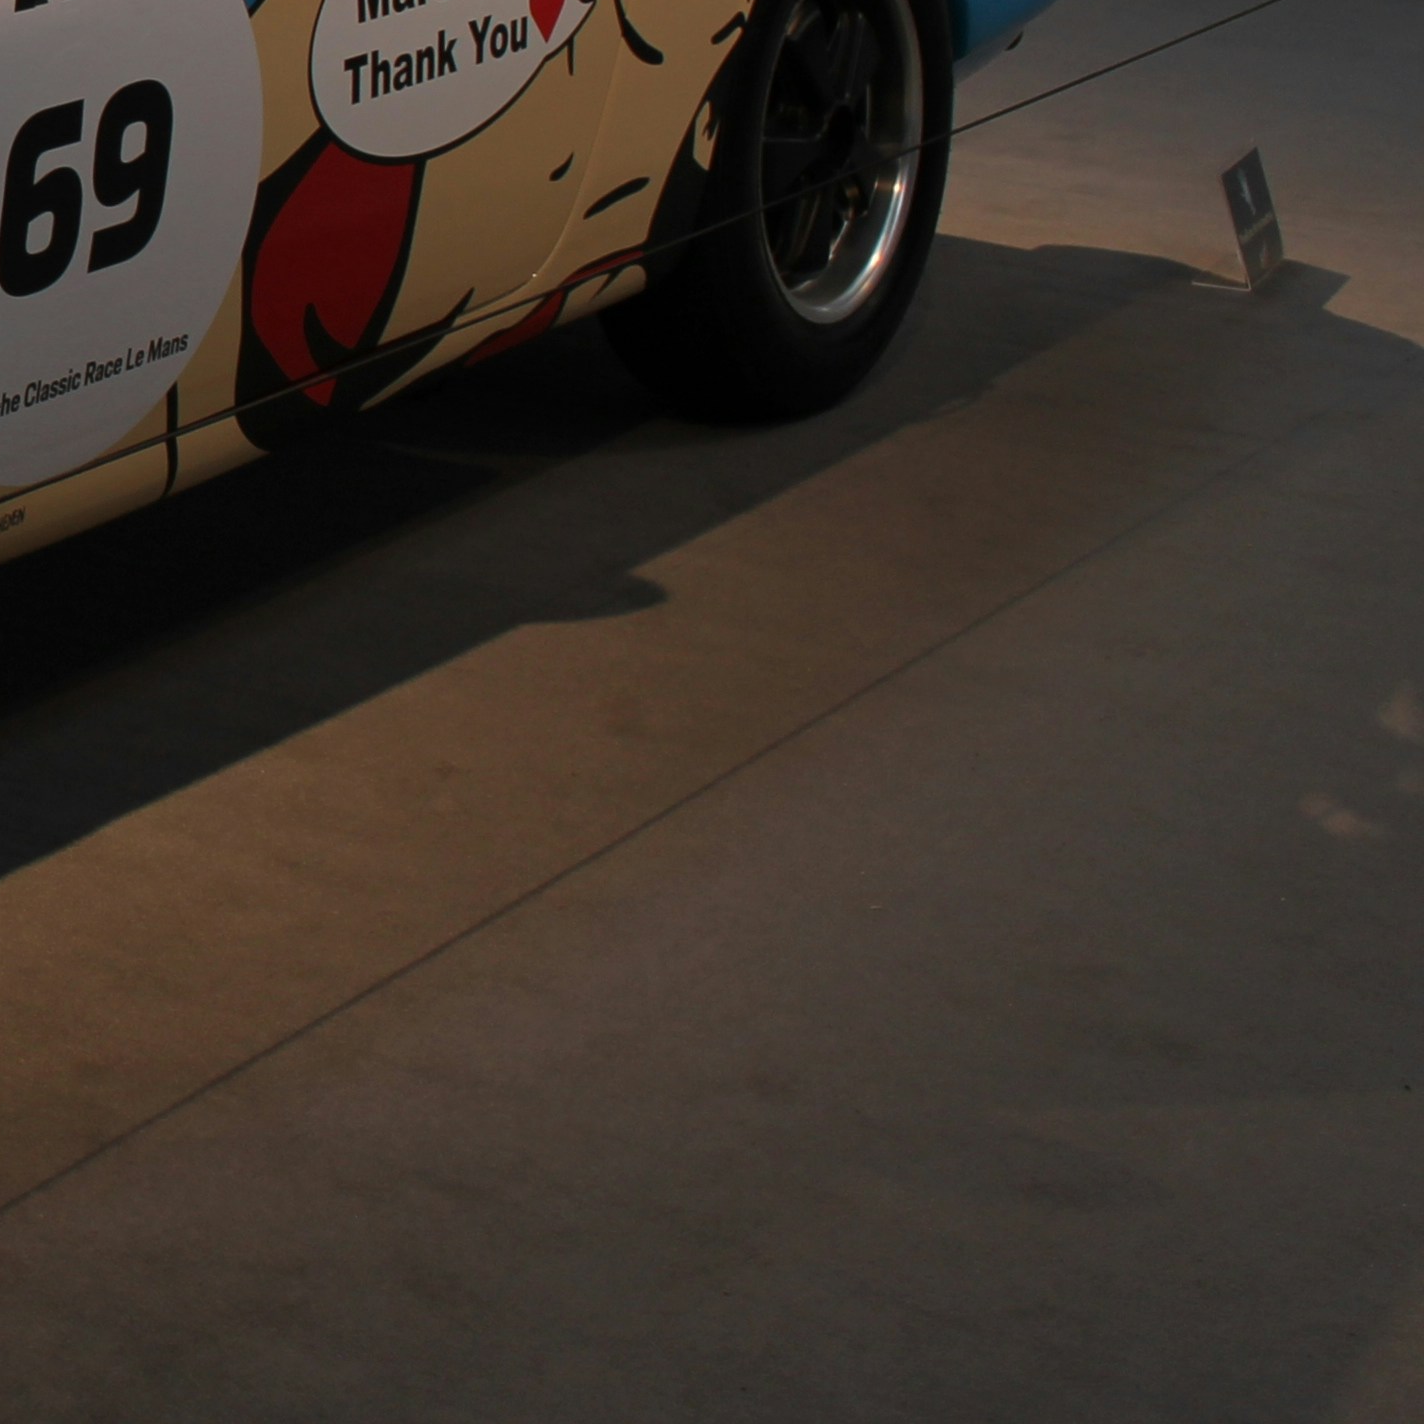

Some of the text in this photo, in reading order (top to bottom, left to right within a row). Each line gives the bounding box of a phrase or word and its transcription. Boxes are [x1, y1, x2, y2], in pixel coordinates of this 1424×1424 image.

[344, 13, 529, 106] Thank You
[24, 368, 82, 408] Classic
[83, 356, 123, 387] Race
[125, 347, 145, 372] Le
[147, 333, 189, 364] Mans
